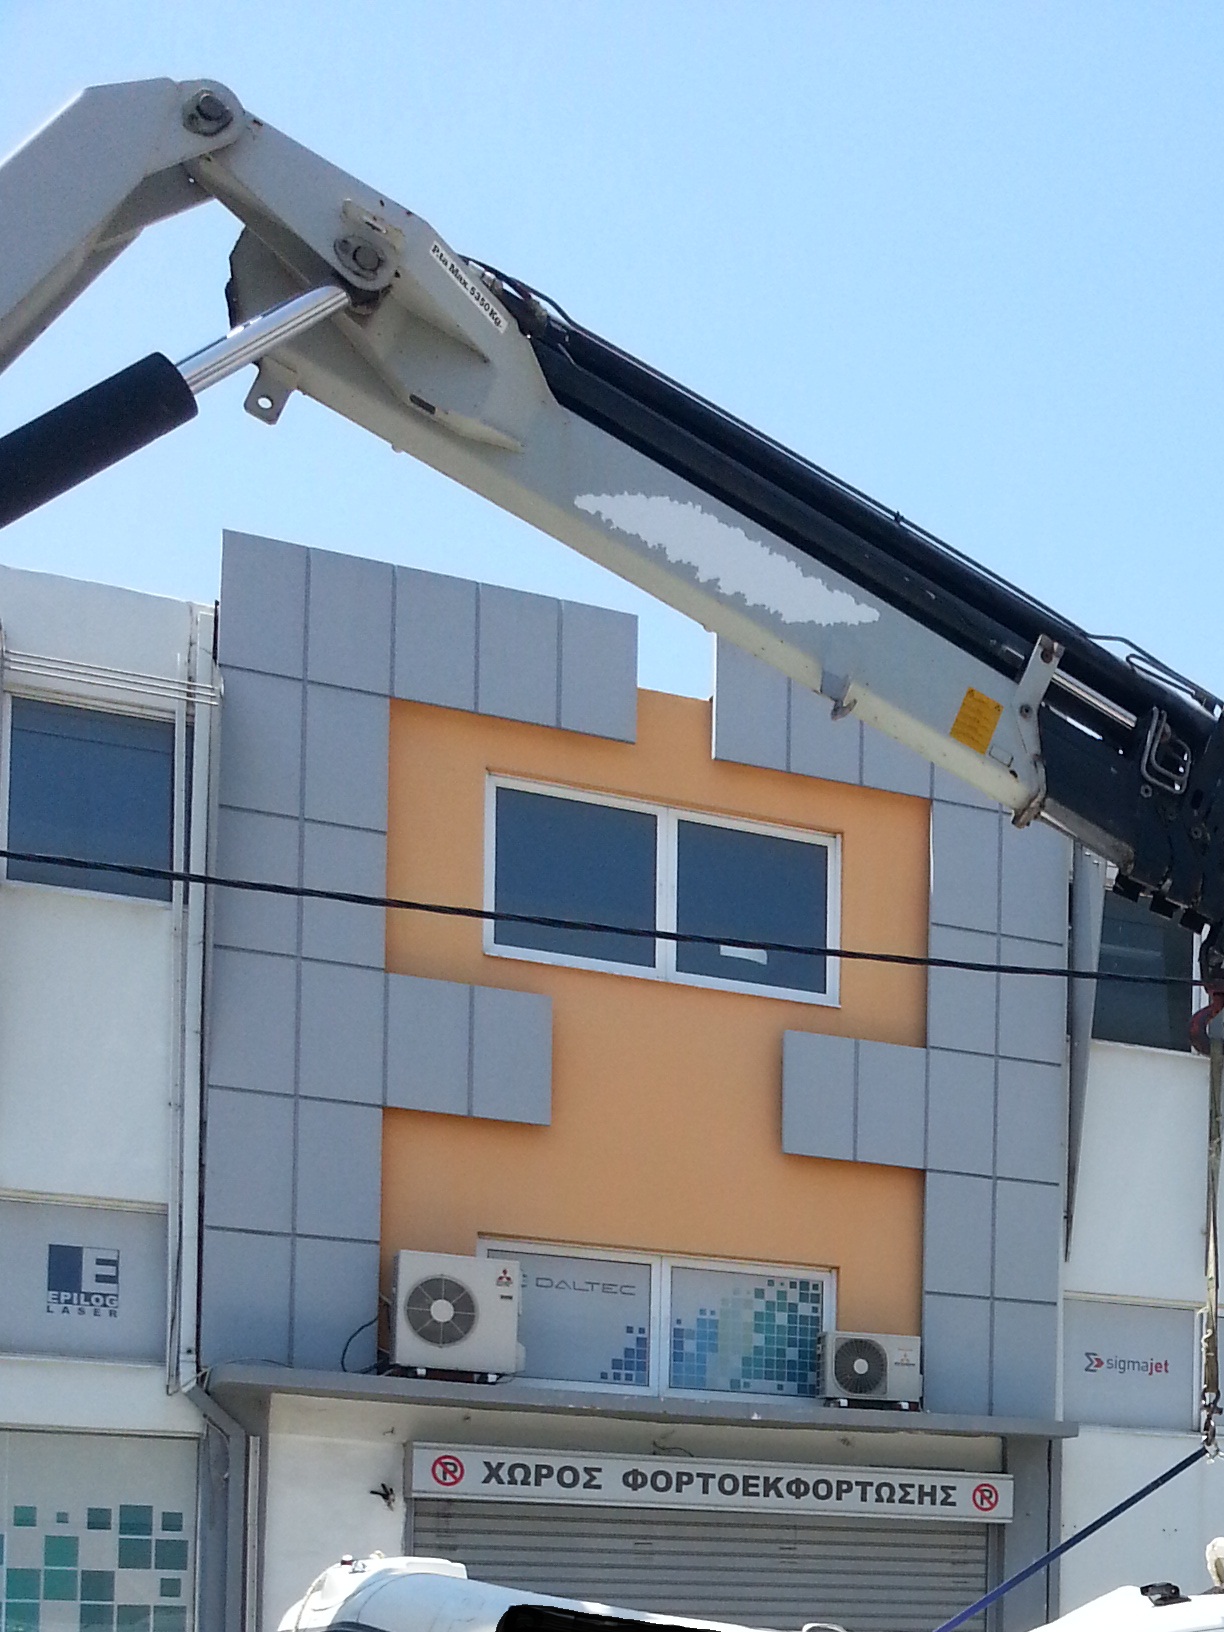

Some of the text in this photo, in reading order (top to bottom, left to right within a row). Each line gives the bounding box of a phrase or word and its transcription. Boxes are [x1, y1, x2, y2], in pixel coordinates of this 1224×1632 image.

[535, 1277, 636, 1296] DALTEC
[48, 1291, 119, 1308] EPILOG
[46, 1305, 118, 1318] LASER
[1106, 1355, 1169, 1376] sigmajet
[481, 1460, 957, 1507] ΧΩΡΟΣ ΦΟΡΤΟΕΚΦΟΡΤΩΣΗΣ
